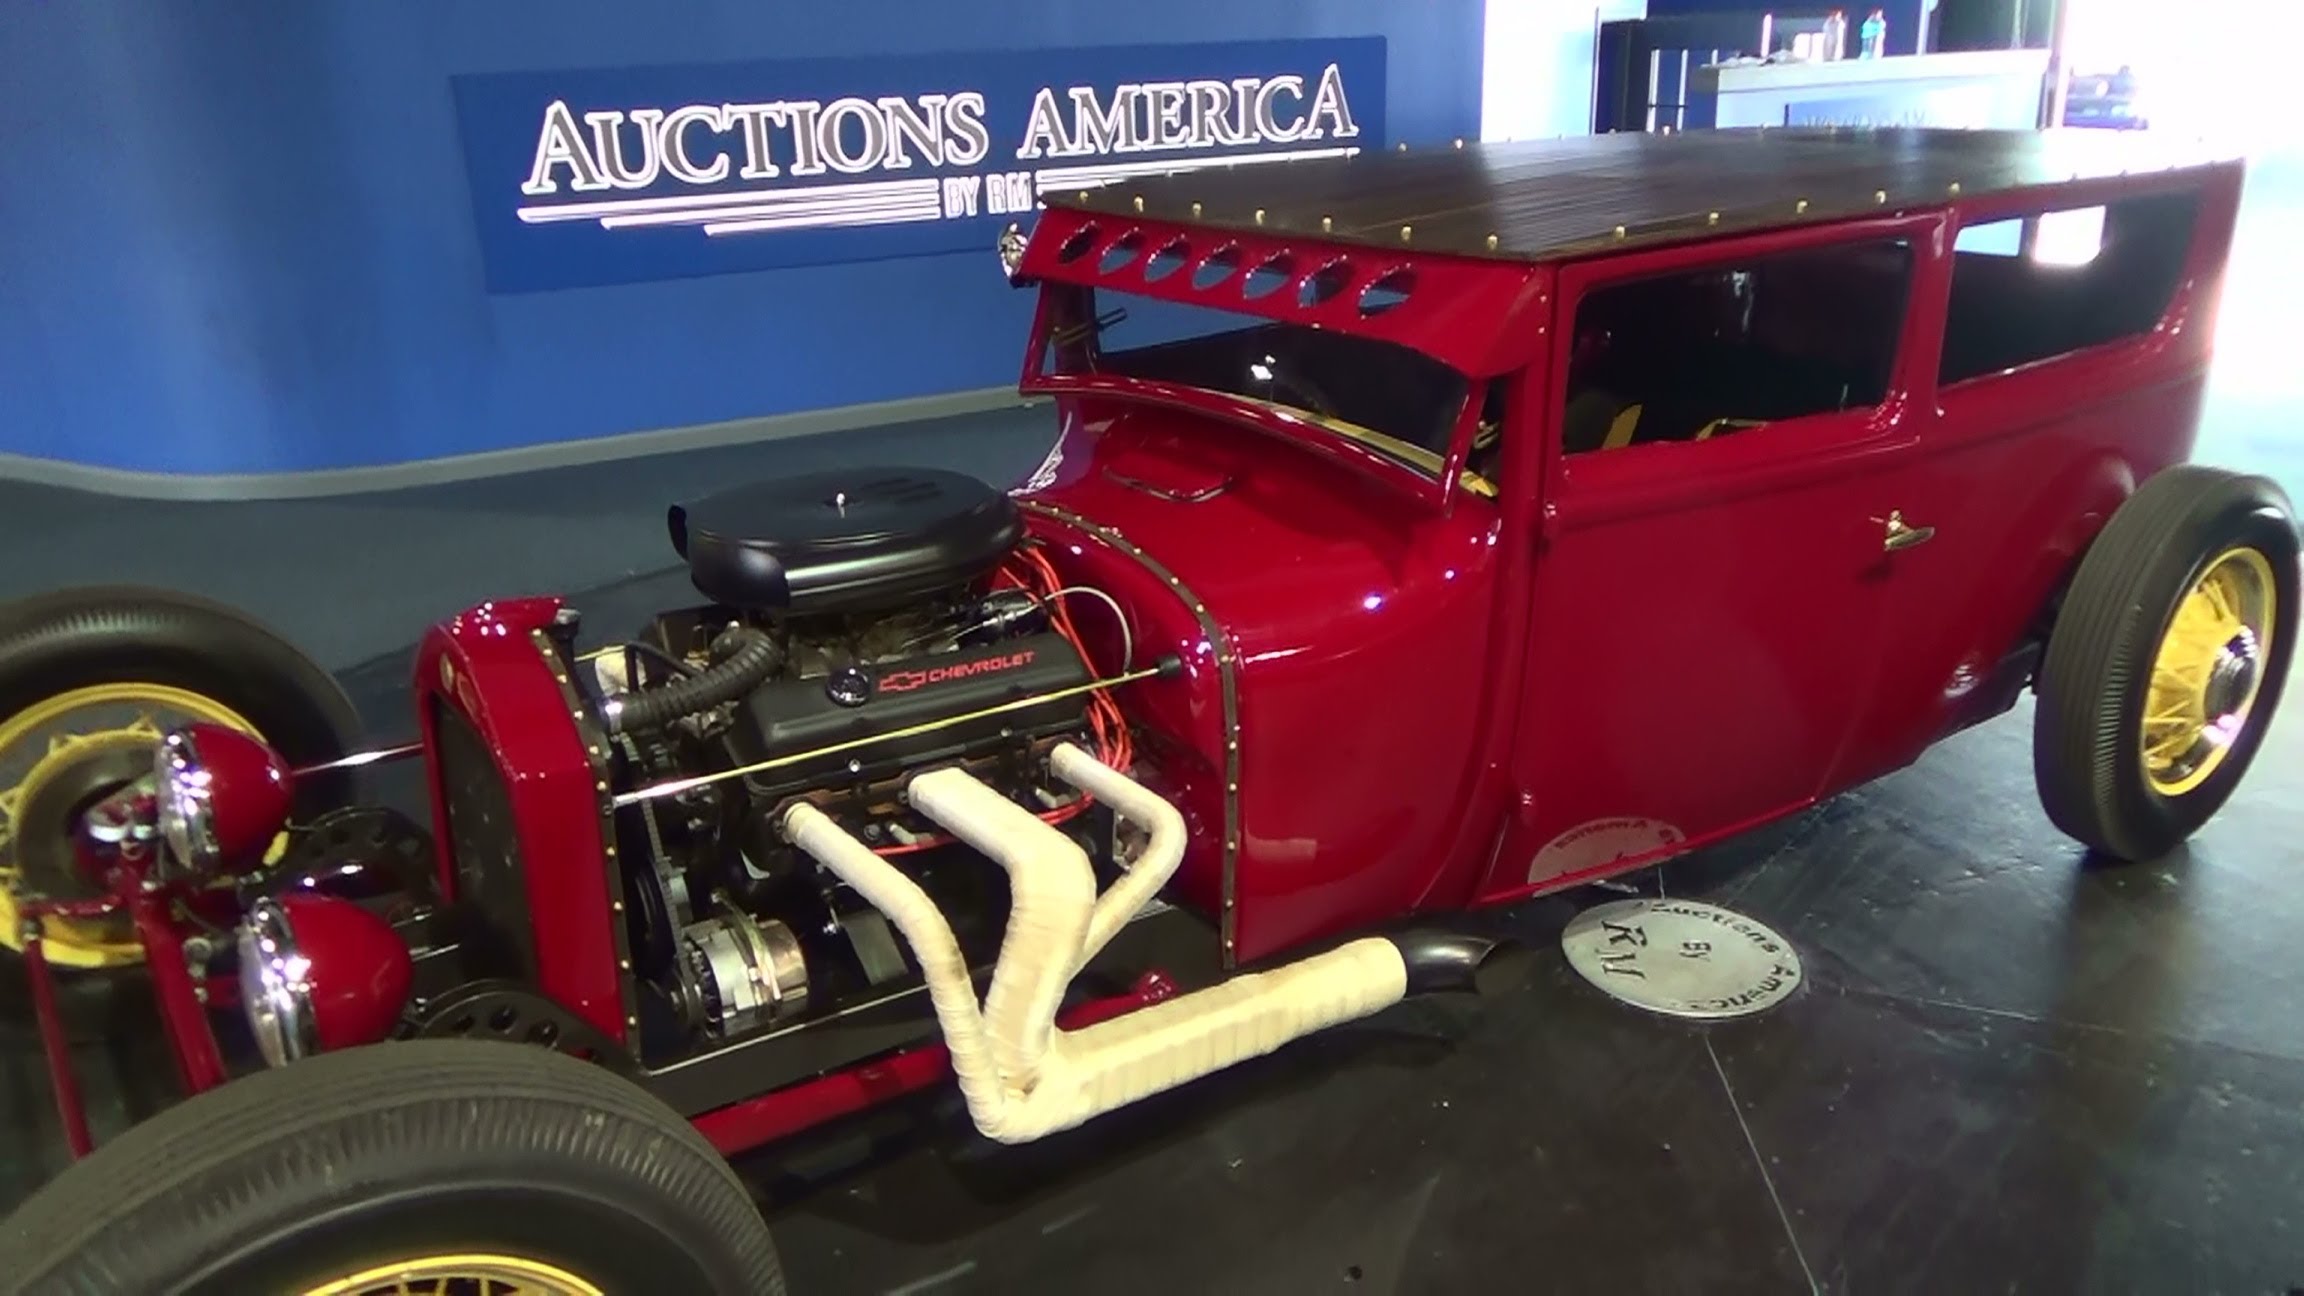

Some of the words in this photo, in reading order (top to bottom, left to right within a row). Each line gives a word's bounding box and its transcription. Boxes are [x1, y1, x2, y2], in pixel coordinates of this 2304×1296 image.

[521, 92, 989, 195] AUCTIONS
[1016, 63, 1360, 159] AMERICA
[943, 176, 981, 218] BY
[986, 171, 1033, 214] RM
[930, 651, 1035, 682] CHEVROLET
[1692, 963, 1797, 1011] Americ
